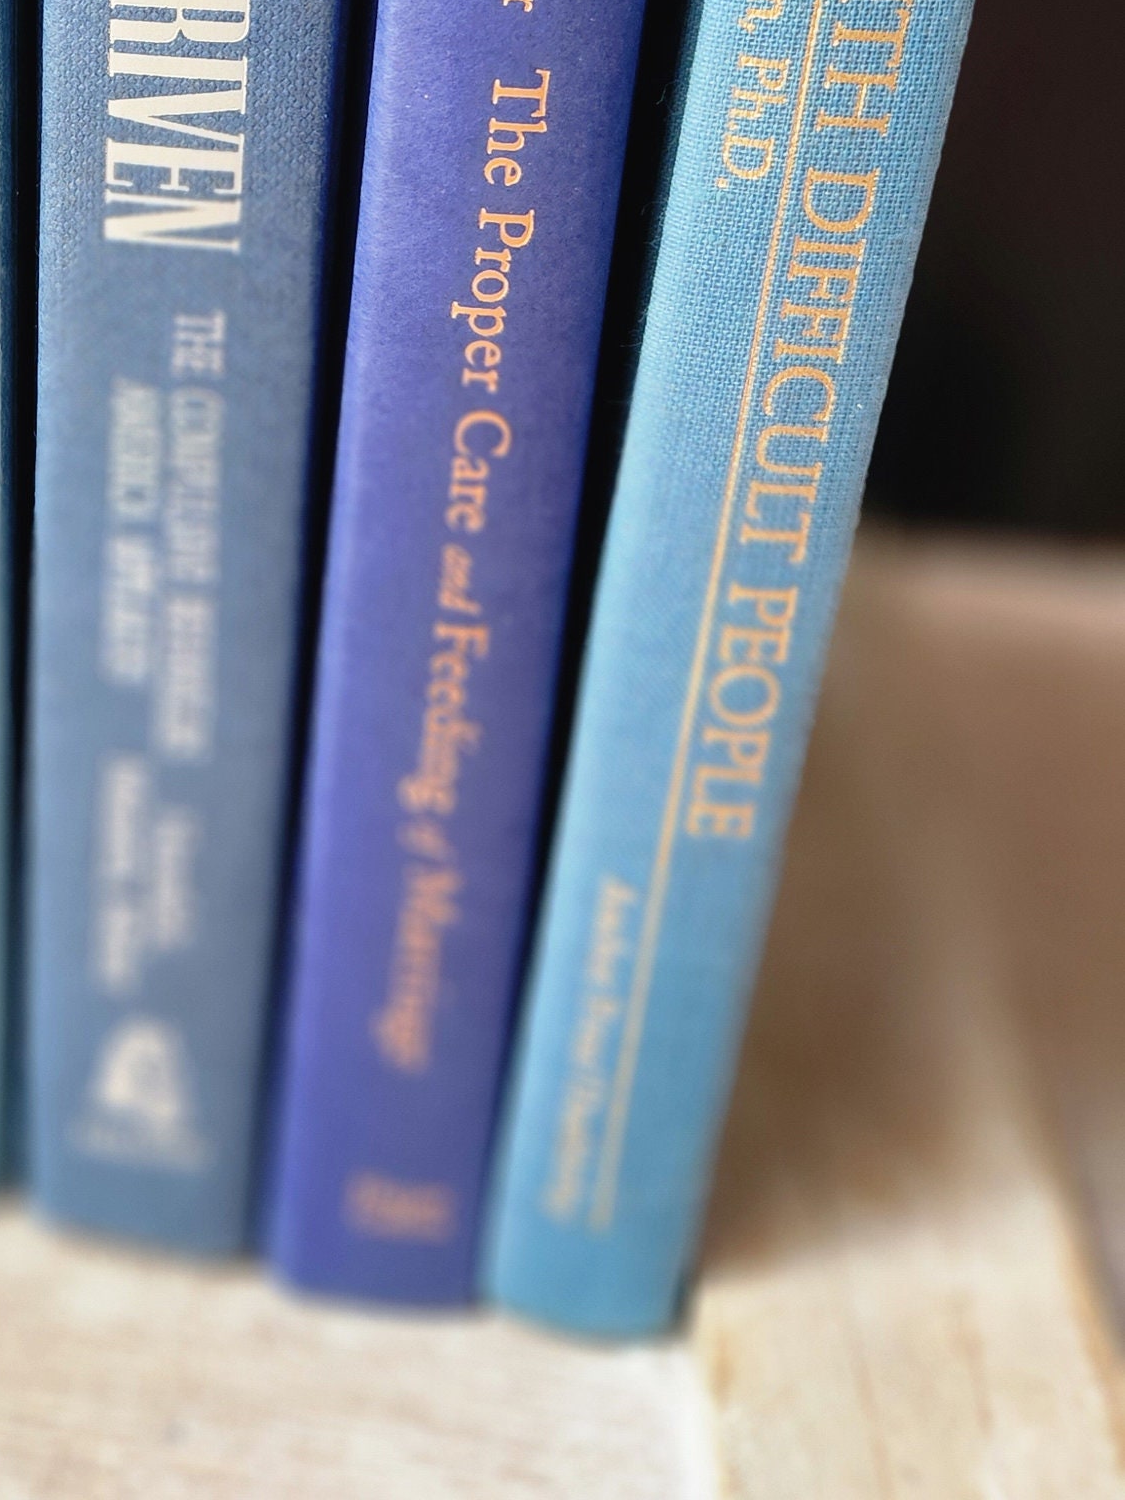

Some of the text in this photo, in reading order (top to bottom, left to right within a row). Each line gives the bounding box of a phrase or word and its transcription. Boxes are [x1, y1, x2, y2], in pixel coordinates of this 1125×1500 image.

[483, 69, 553, 187] The
[172, 309, 227, 377] THE
[451, 208, 536, 393] Proper
[739, 167, 881, 564] DIFFICULT
[445, 409, 513, 533] Care
[685, 582, 798, 841] PEOPLE
